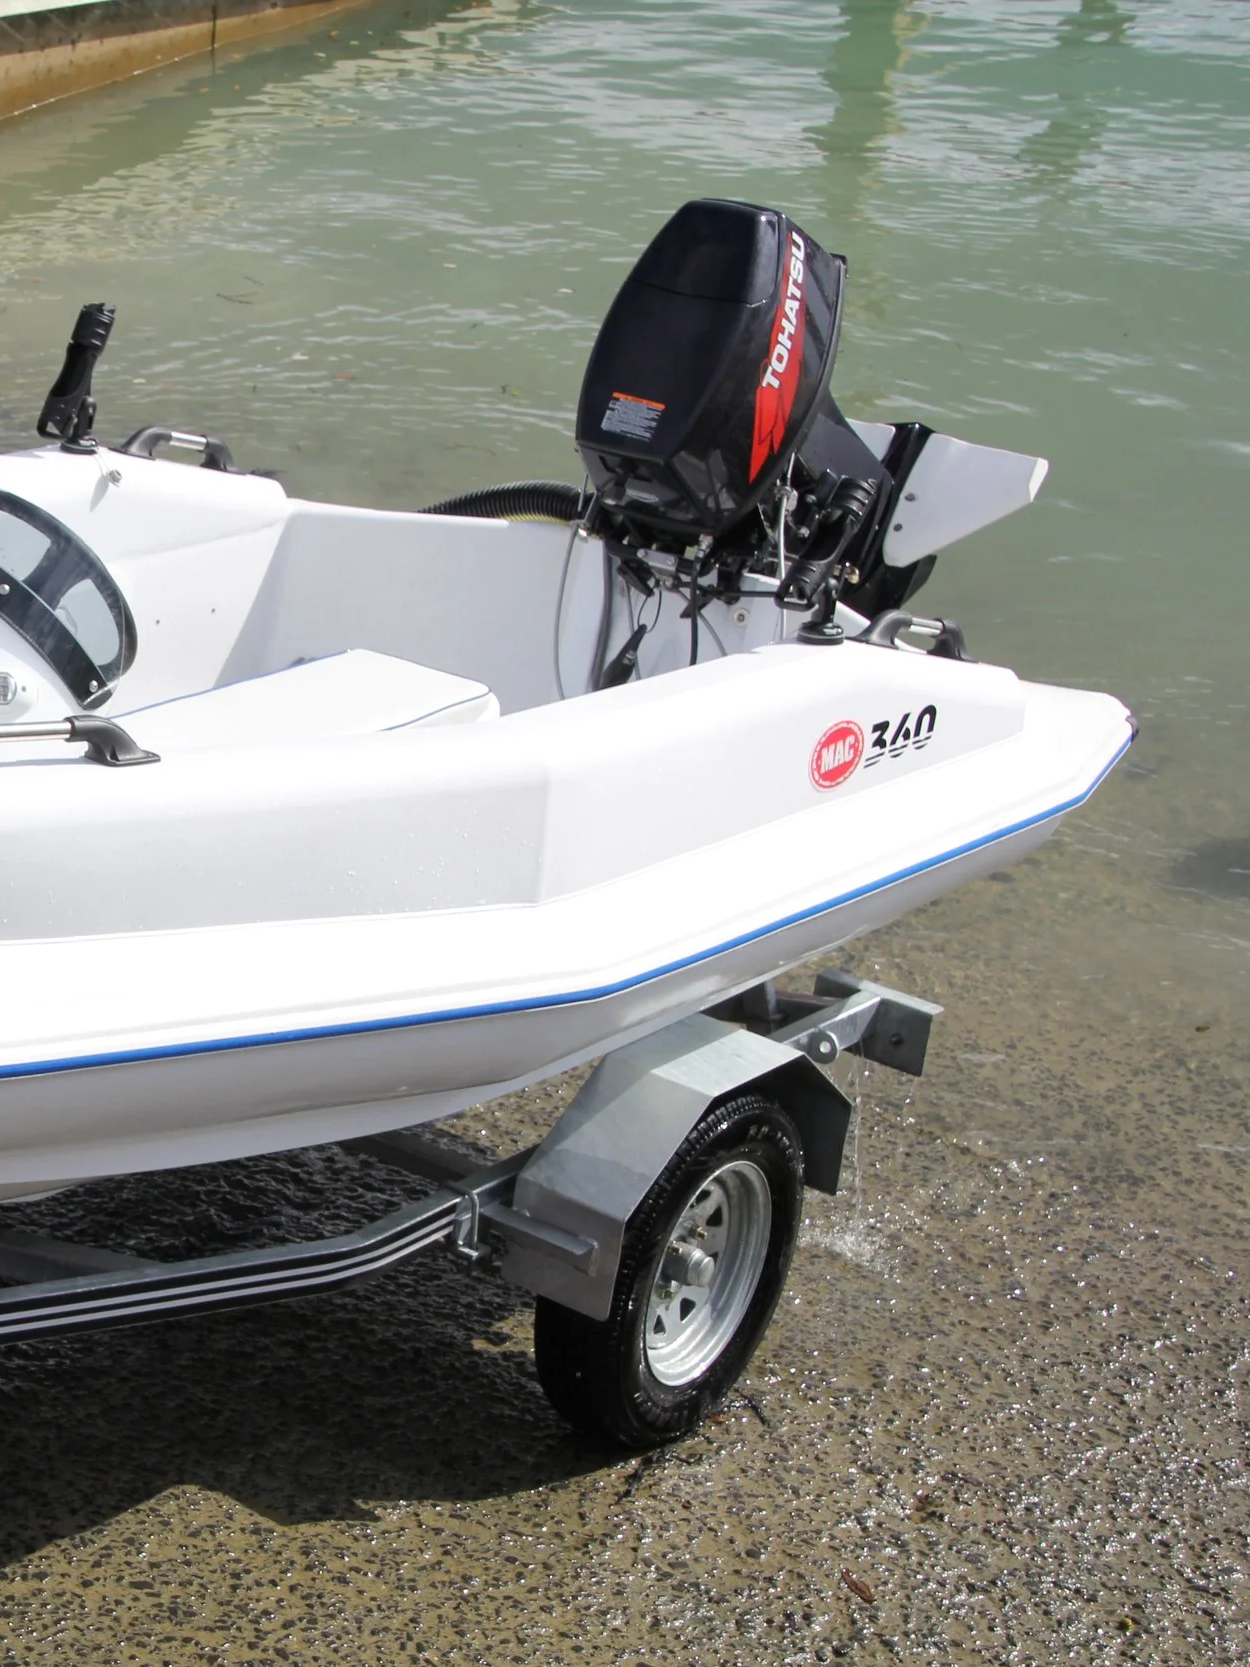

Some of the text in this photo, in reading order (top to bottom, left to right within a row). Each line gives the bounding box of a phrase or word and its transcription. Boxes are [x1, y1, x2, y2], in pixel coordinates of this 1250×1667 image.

[761, 231, 806, 389] TOHATSU
[819, 704, 937, 775] MAC 360
